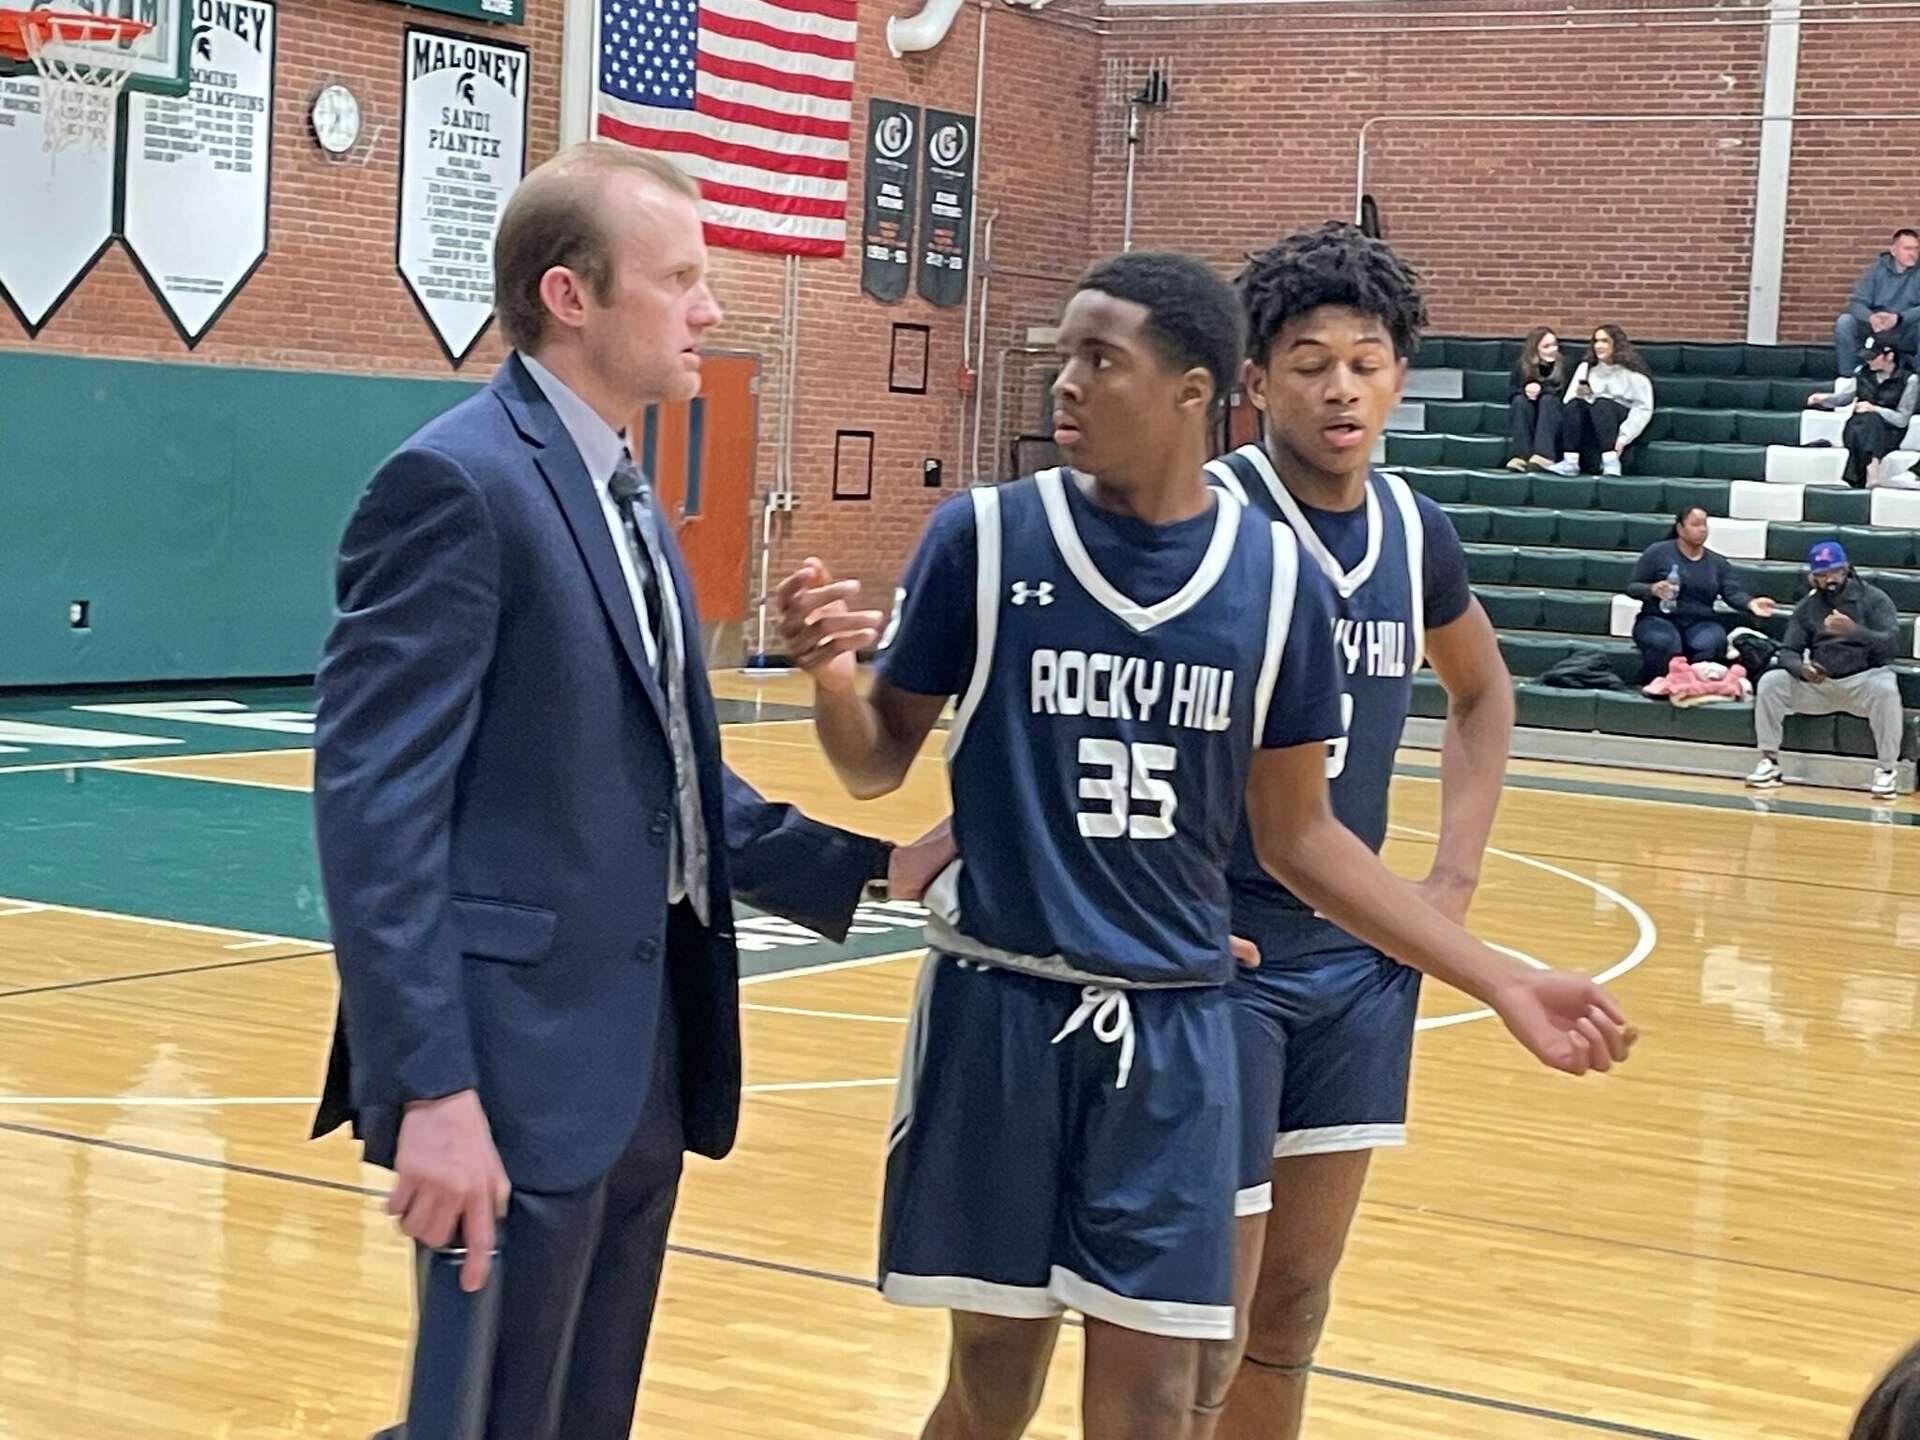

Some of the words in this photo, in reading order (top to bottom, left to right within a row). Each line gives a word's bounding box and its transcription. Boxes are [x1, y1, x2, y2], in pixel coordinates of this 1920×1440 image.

[412, 38, 521, 98] MALONEY
[428, 129, 501, 158] PIANTEK
[441, 106, 491, 132] SANDI
[1367, 620, 1407, 678] HILL
[1030, 648, 1164, 722] ROCKY
[1168, 662, 1233, 732] HILL
[1076, 736, 1179, 841] 35
